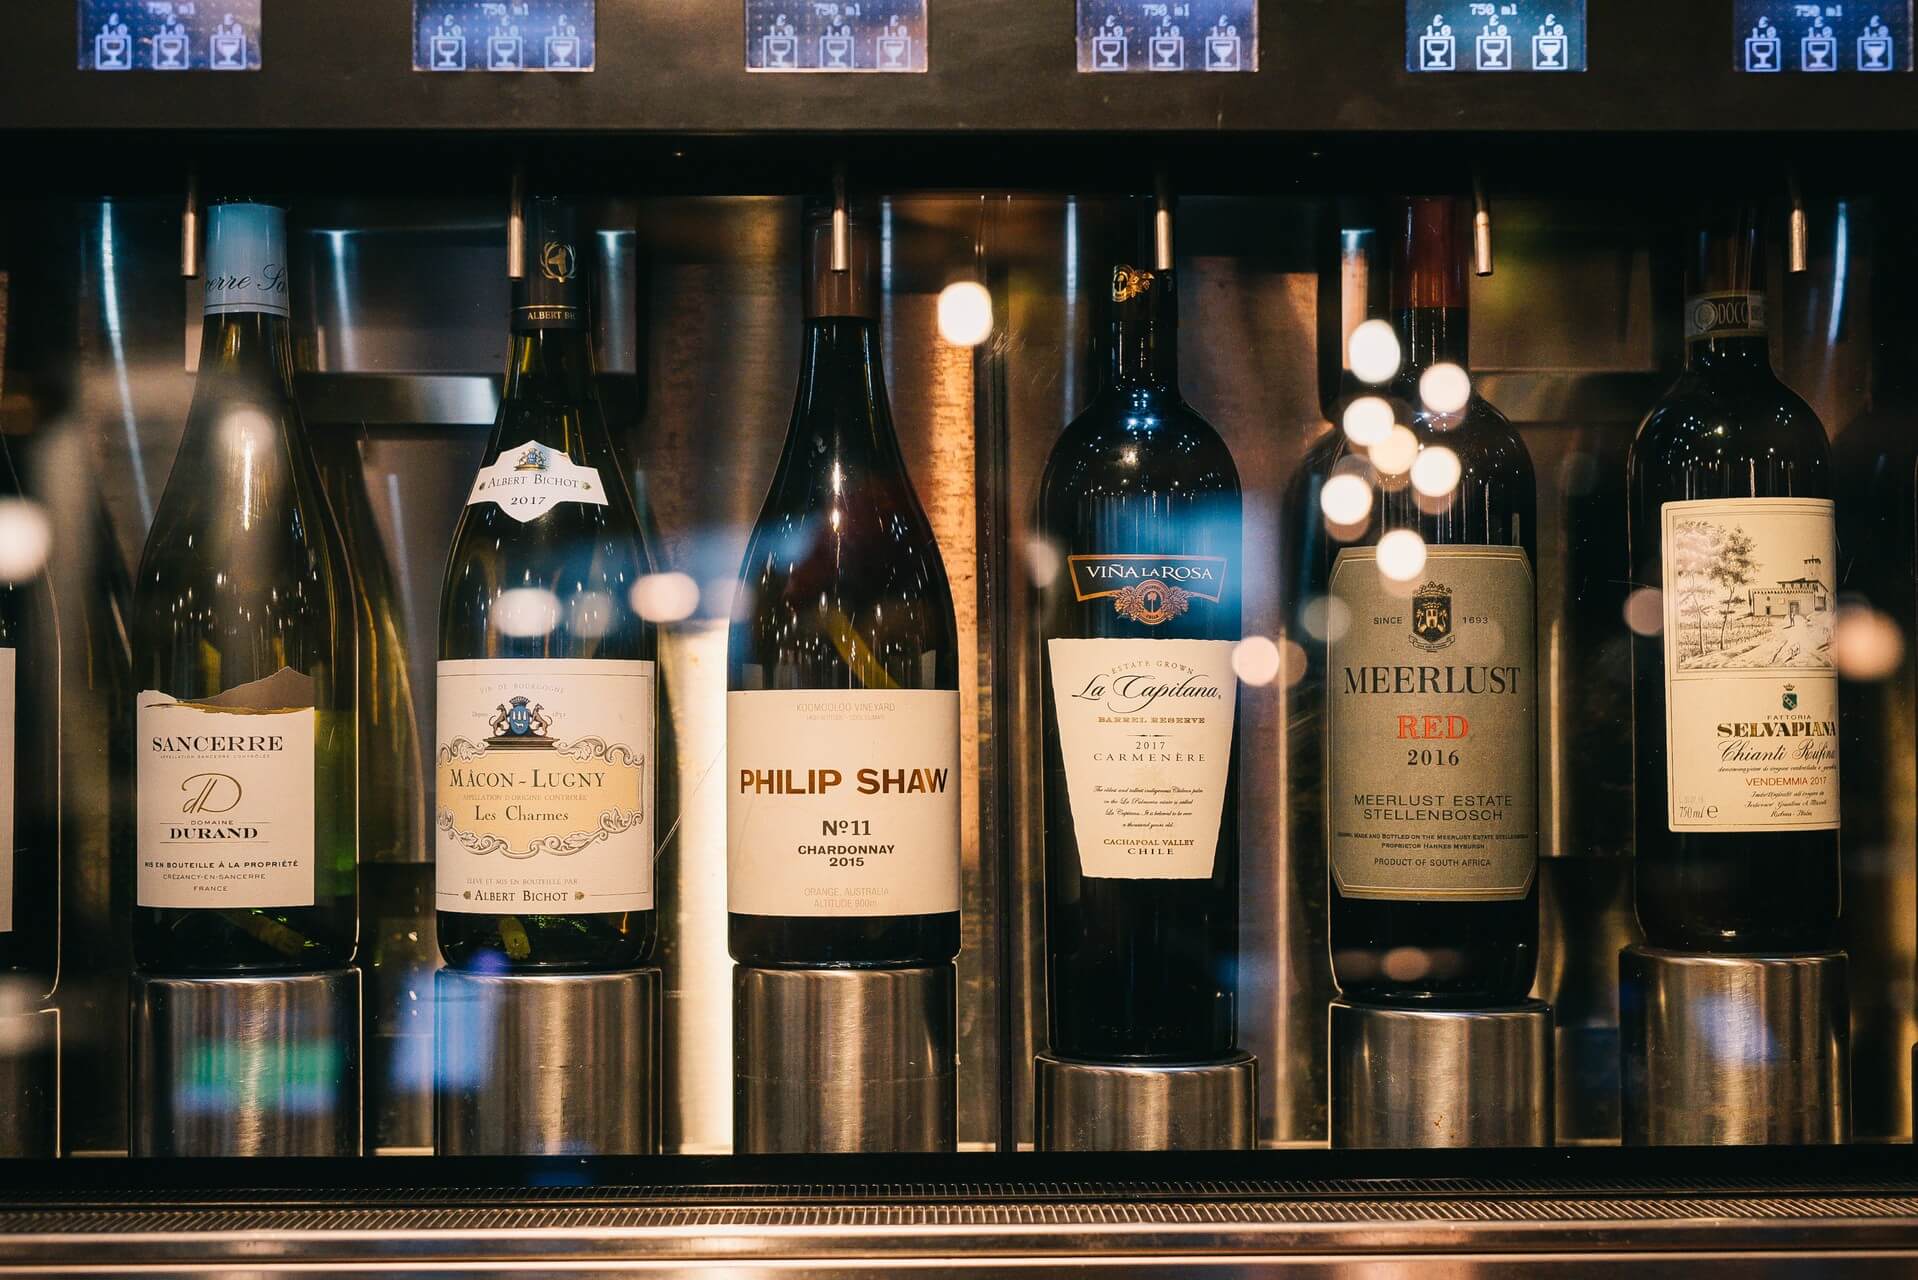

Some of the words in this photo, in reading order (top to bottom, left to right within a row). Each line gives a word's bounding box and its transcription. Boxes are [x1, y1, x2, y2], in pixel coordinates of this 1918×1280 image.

[481, 3, 506, 16] 750
[513, 3, 529, 16] ml
[1143, 4, 1167, 17] 750
[1174, 4, 1190, 17] ml
[1469, 3, 1495, 16] 750
[1501, 3, 1518, 16] ml
[528, 311, 562, 320] ALBERT
[488, 476, 527, 489] ALBERT
[534, 474, 579, 488] BICHOT
[511, 496, 546, 505] 2017
[1086, 564, 1139, 578] VIÑA
[1373, 616, 1403, 625] SINCE
[1462, 616, 1488, 625] 1693
[1111, 660, 1151, 675] ESTATE
[1156, 660, 1194, 675] GROWN
[1072, 674, 1109, 700] La
[1344, 667, 1521, 694] MEERLUST
[854, 702, 896, 712] VINEYARD
[1396, 715, 1469, 739] RED
[1717, 722, 1836, 737] SELVAPIANA
[152, 736, 283, 752] SANCERRE
[1135, 741, 1165, 750] 2017
[1718, 740, 1786, 761] Chianti
[1093, 752, 1206, 762] CARMENÈRE
[1407, 749, 1459, 766] 2016
[740, 769, 842, 794] PHILIP
[856, 768, 948, 794] SHAW
[1745, 778, 1808, 786] VENDEMMIA
[1810, 777, 1827, 785] 2017
[1354, 794, 1445, 807] MEERLUST
[1453, 794, 1513, 807] ESTATE
[475, 805, 496, 821] Les
[505, 805, 569, 821] Charmes
[1363, 809, 1503, 821] STELLENBOSCH
[170, 827, 258, 839] DURAND
[798, 845, 895, 855] CHARDONNAY
[218, 860, 225, 868] À
[244, 860, 299, 868] PROPRIÉTÉ
[829, 857, 865, 867] 2015
[1374, 858, 1413, 866] PRODUCT
[1430, 859, 1459, 867] SOUTH
[1461, 858, 1491, 867] AFRICA
[474, 890, 516, 902] ALBERT
[523, 890, 569, 902] BICHOT
[844, 887, 889, 896] AUSTRALIA
